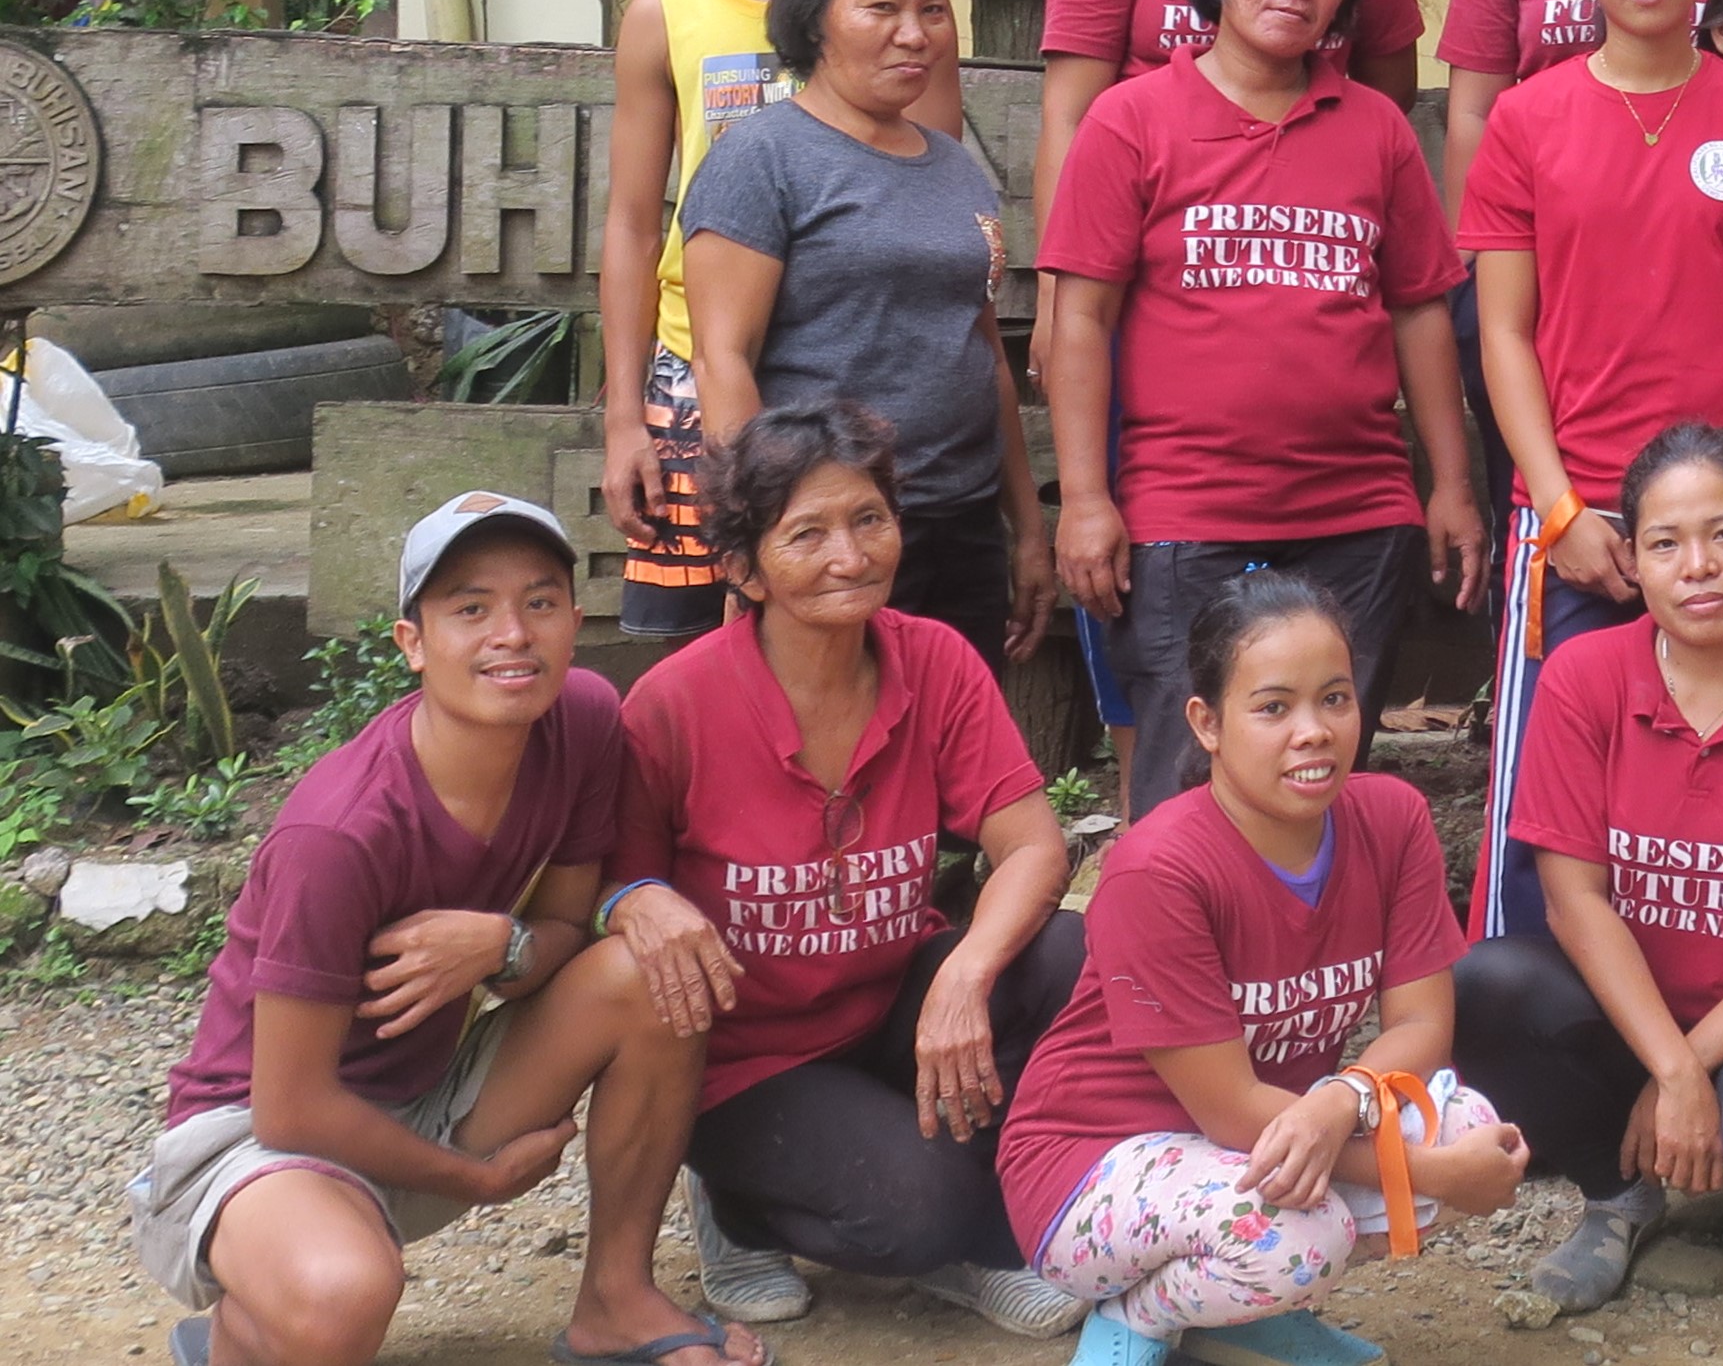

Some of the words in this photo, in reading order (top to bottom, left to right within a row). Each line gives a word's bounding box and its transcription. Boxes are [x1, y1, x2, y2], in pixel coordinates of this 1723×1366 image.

[1541, 25, 1596, 45] SAVE
[704, 68, 771, 86] PURSUING
[704, 84, 759, 109] VICTORY
[199, 104, 614, 275] BUHI
[1181, 204, 1380, 250] PRESERVE
[1183, 237, 1361, 273] FUTURE
[1182, 268, 1242, 288] SAVE
[1246, 268, 1300, 285] OUR
[726, 876, 923, 931] FUTURE
[1639, 904, 1697, 932] OUR
[725, 926, 792, 956] SAVE
[798, 928, 858, 957] OUR
[863, 909, 920, 949] NATU
